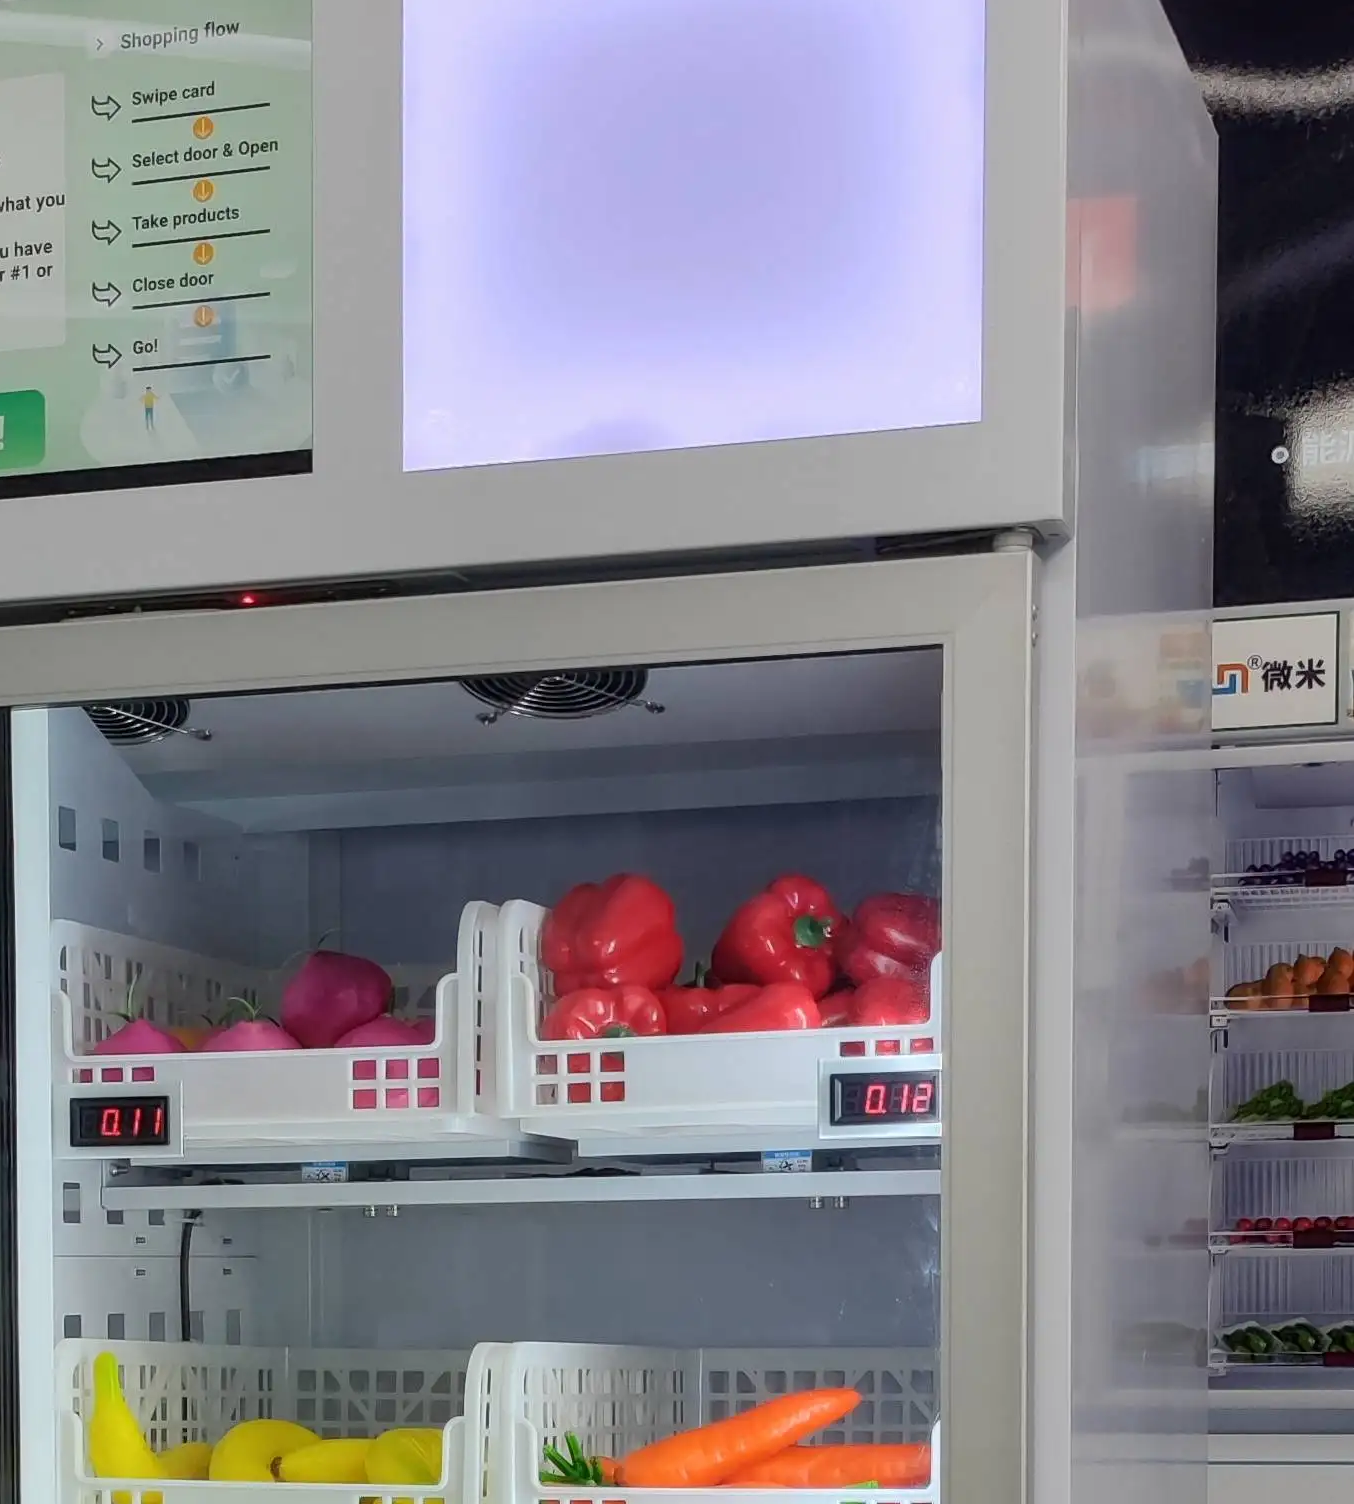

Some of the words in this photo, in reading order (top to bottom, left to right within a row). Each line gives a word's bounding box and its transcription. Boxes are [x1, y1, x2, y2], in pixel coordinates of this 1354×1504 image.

[120, 26, 199, 49] Shopping
[204, 21, 240, 38] flow
[132, 88, 178, 106] Swipe
[182, 81, 215, 98] card
[132, 149, 179, 168] Select
[183, 146, 218, 162] door
[222, 143, 233, 158] &
[238, 140, 279, 157] Open
[36, 193, 66, 212] you
[132, 214, 168, 231] Take
[173, 206, 240, 230] products
[14, 241, 53, 258] have
[10, 265, 29, 280] #1
[36, 264, 53, 278] or
[132, 277, 175, 293] Close
[179, 273, 214, 287] door
[132, 339, 158, 355] Go!
[1301, 428, 1354, 468] 能
[1261, 657, 1327, 694] 微米
[865, 1084, 933, 1114] 0.12
[101, 1108, 162, 1136] 0.11
